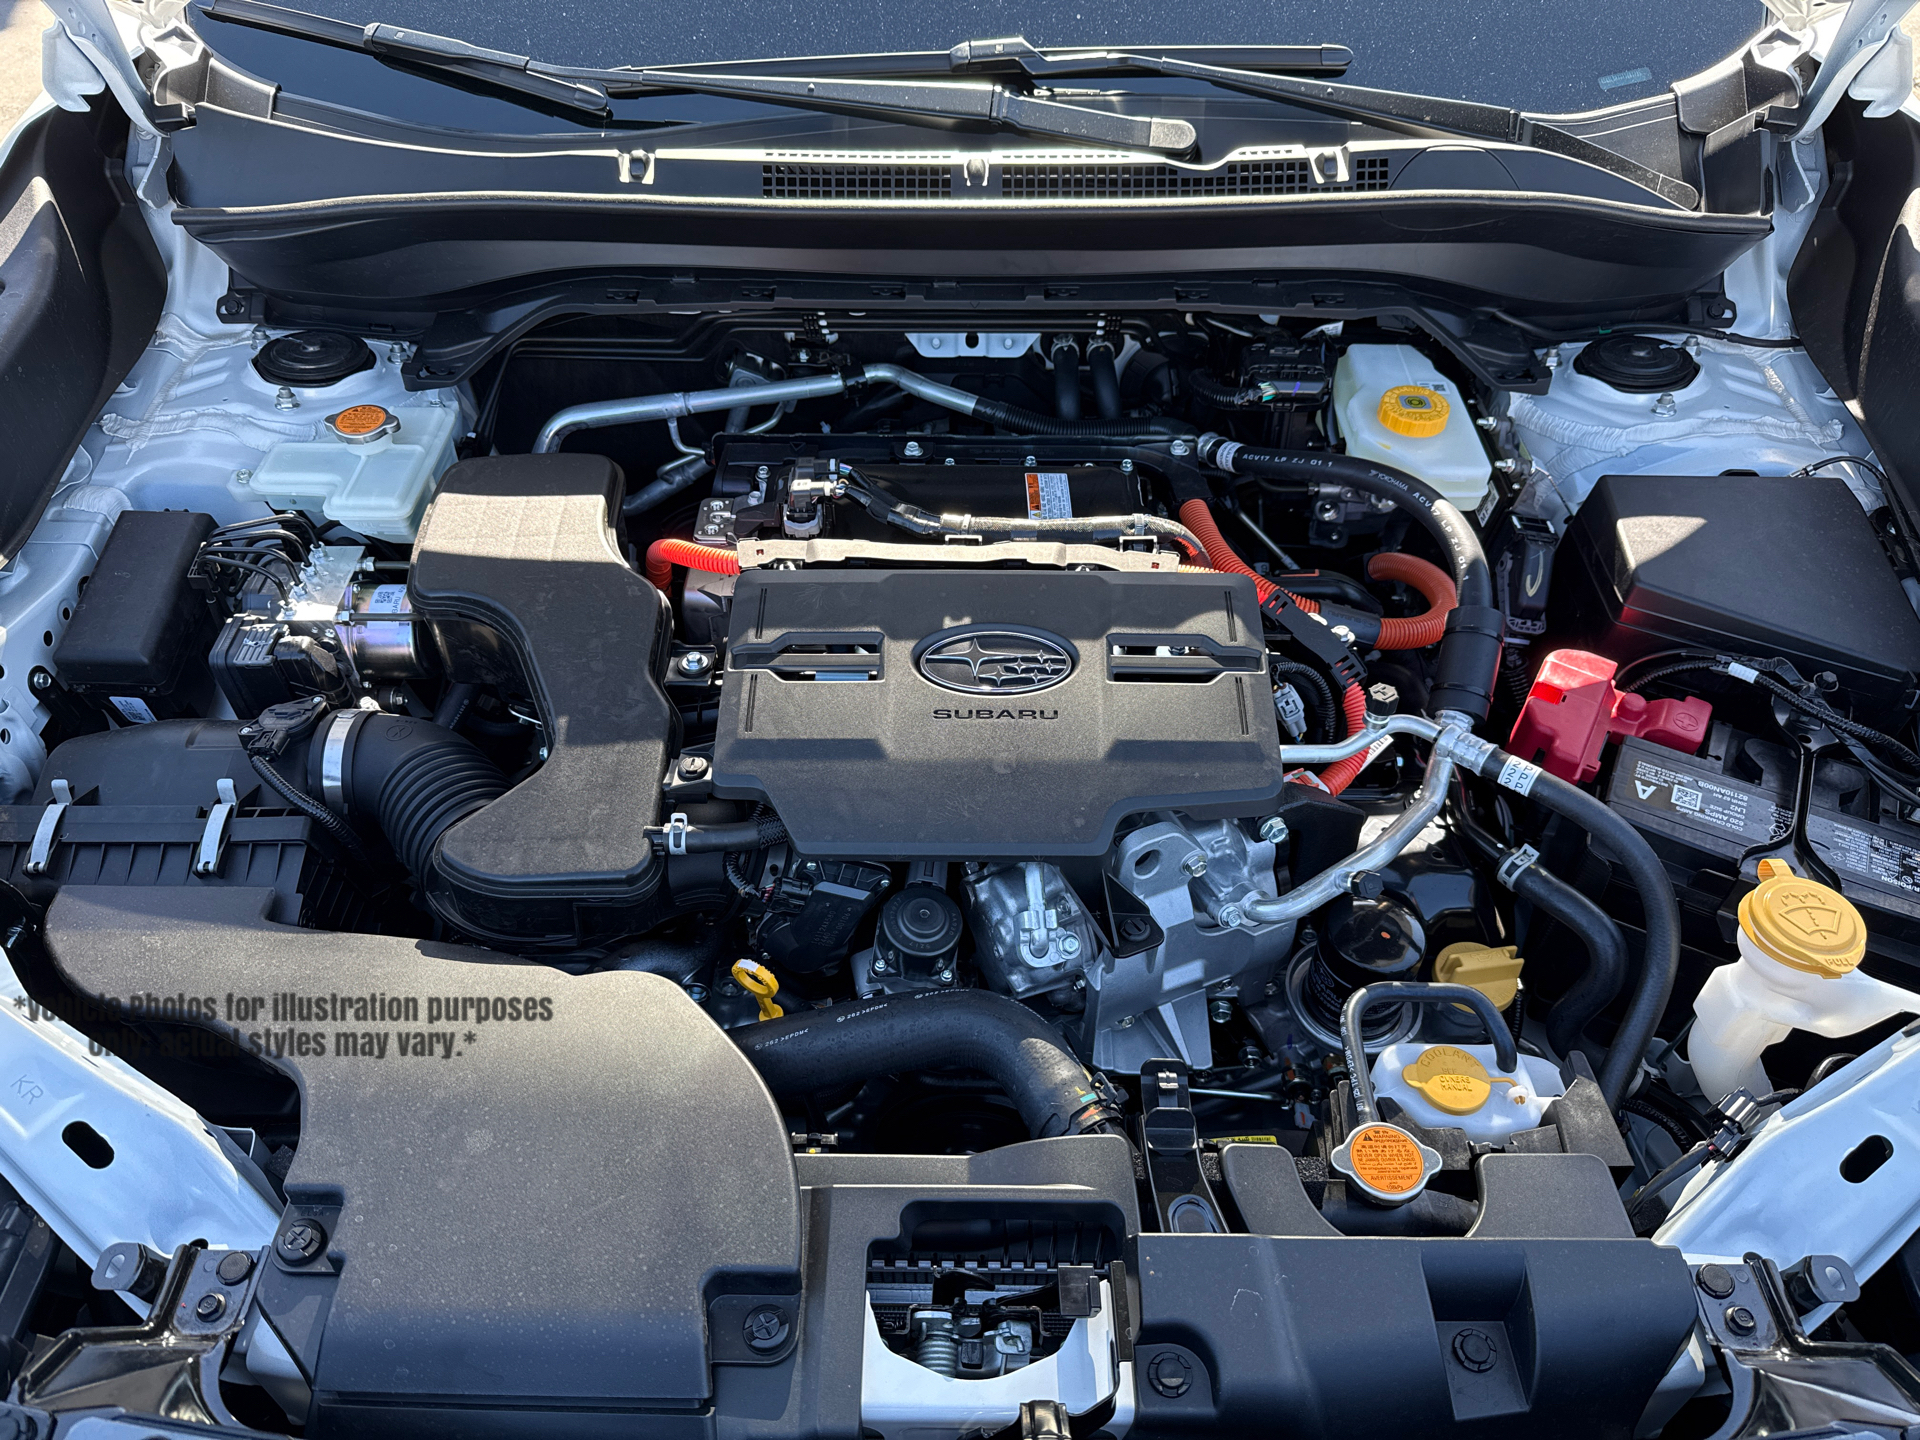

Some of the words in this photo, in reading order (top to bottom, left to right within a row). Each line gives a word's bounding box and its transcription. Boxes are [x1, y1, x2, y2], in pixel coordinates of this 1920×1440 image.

[1242, 453, 1270, 462] ACV17
[1377, 472, 1409, 492] YOKOHAMA
[1412, 491, 1441, 516] ACV17
[1441, 520, 1453, 533] LP
[932, 709, 1059, 720] SUBARU
[1675, 805, 1693, 814] AMPS
[1708, 803, 1723, 811] SIZE
[1729, 804, 1746, 813] LN2
[1693, 811, 1725, 825] CRANKING
[1703, 808, 1728, 820] AMPS
[1722, 808, 1745, 819] GROUP
[1725, 822, 1743, 831] COLD
[1728, 817, 1744, 826] 620
[1420, 1048, 1480, 1067] COOLANT
[10, 1074, 44, 1104] KR
[1440, 1083, 1473, 1092] MANUAL
